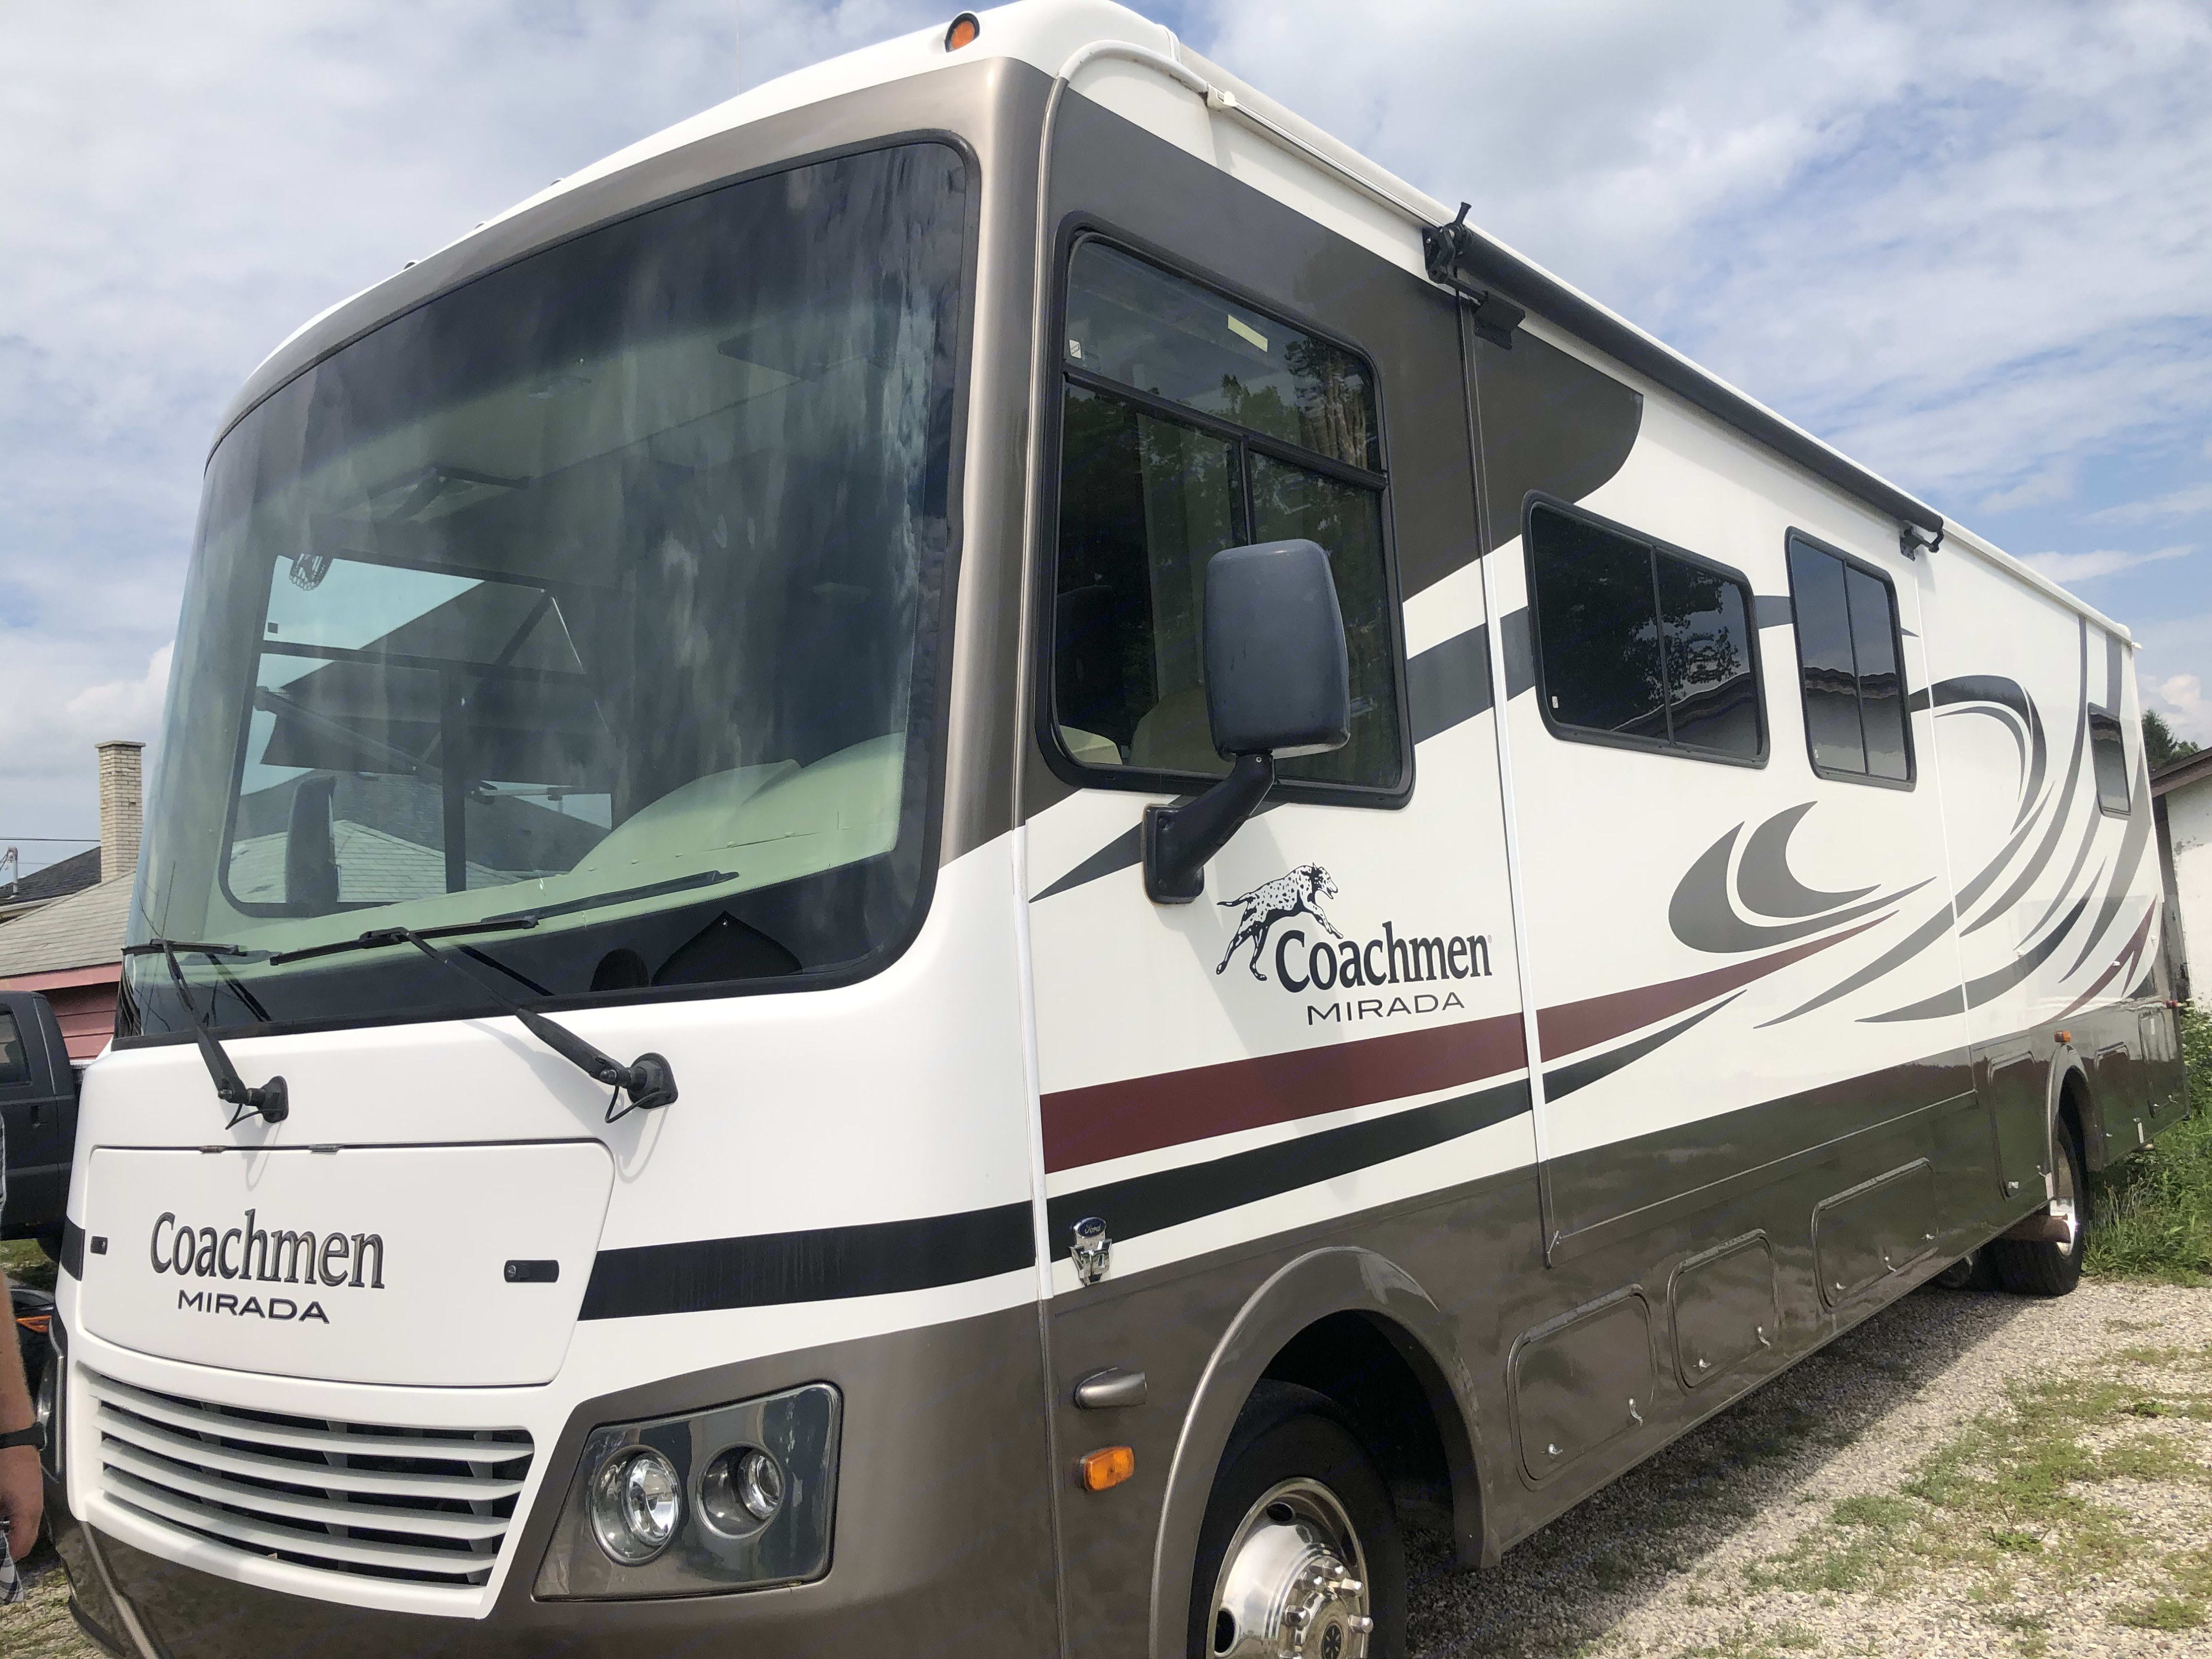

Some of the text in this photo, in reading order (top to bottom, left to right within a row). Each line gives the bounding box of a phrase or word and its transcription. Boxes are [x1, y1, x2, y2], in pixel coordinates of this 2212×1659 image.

[1275, 921, 1493, 993] Coachmen
[1307, 992, 1465, 1025] MIRADA
[1084, 1224, 1102, 1234] Ford
[150, 1208, 385, 1289] Coachmen
[178, 1289, 330, 1324] MIRADA
